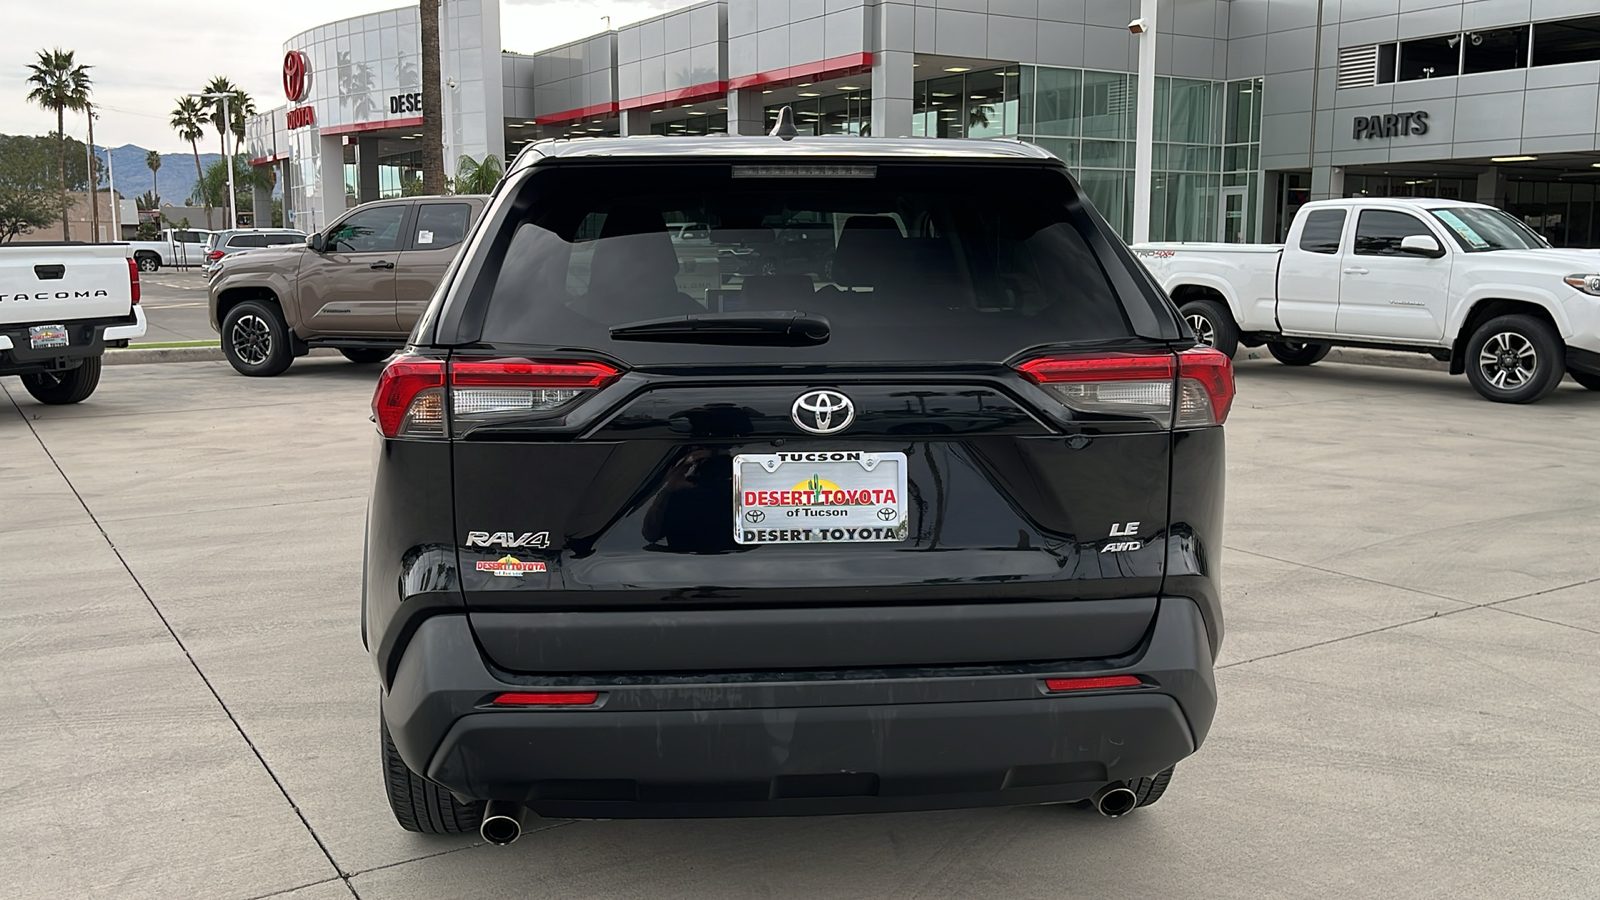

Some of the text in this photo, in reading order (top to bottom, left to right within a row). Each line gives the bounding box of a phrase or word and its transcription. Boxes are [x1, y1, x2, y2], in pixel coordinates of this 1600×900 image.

[390, 93, 423, 114] DESE
[286, 106, 314, 130] TOYOTA
[1353, 110, 1428, 140] PARTS
[778, 453, 861, 462] TUCSON
[744, 489, 896, 506] DESERT TOYOTA
[787, 508, 848, 517] of Tucson
[743, 528, 896, 542] DESERT TOYOTA
[1109, 521, 1140, 537] LE
[465, 531, 550, 549] RAV4
[1101, 541, 1141, 553] AWD
[477, 562, 546, 571] DESERT TOYOTA
